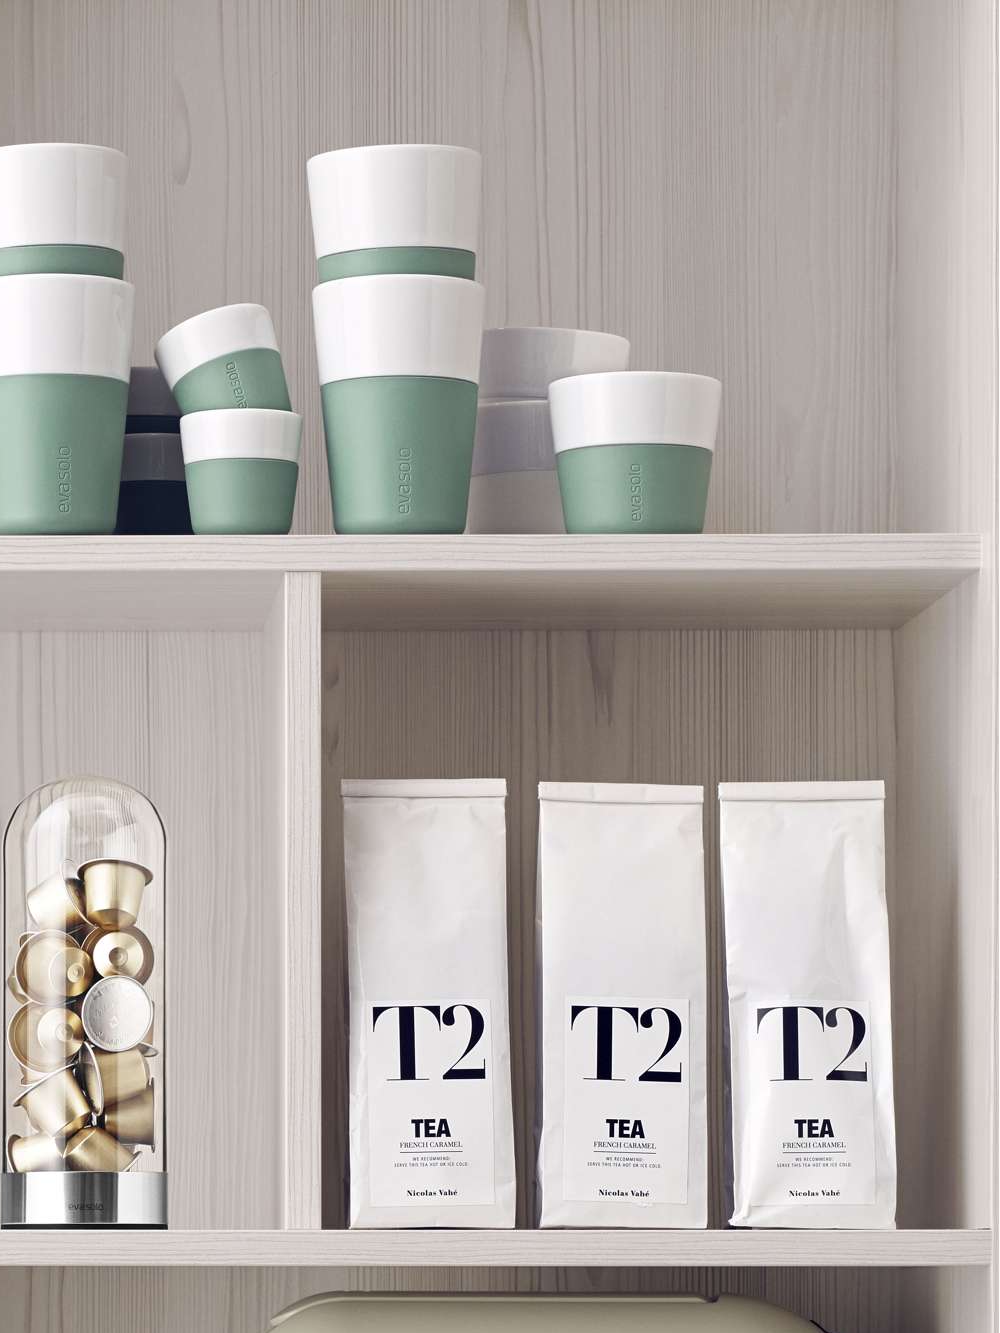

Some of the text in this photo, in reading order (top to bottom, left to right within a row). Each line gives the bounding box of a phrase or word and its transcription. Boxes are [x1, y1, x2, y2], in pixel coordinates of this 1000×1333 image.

[372, 1004, 486, 1081] T2
[571, 1005, 683, 1083] T2
[756, 1006, 868, 1081] T2
[411, 1118, 451, 1138] TEA
[606, 1119, 645, 1139] TEA
[794, 1119, 834, 1138] TEA
[407, 1189, 437, 1197] Nicolas
[821, 1189, 841, 1197] Vahé
